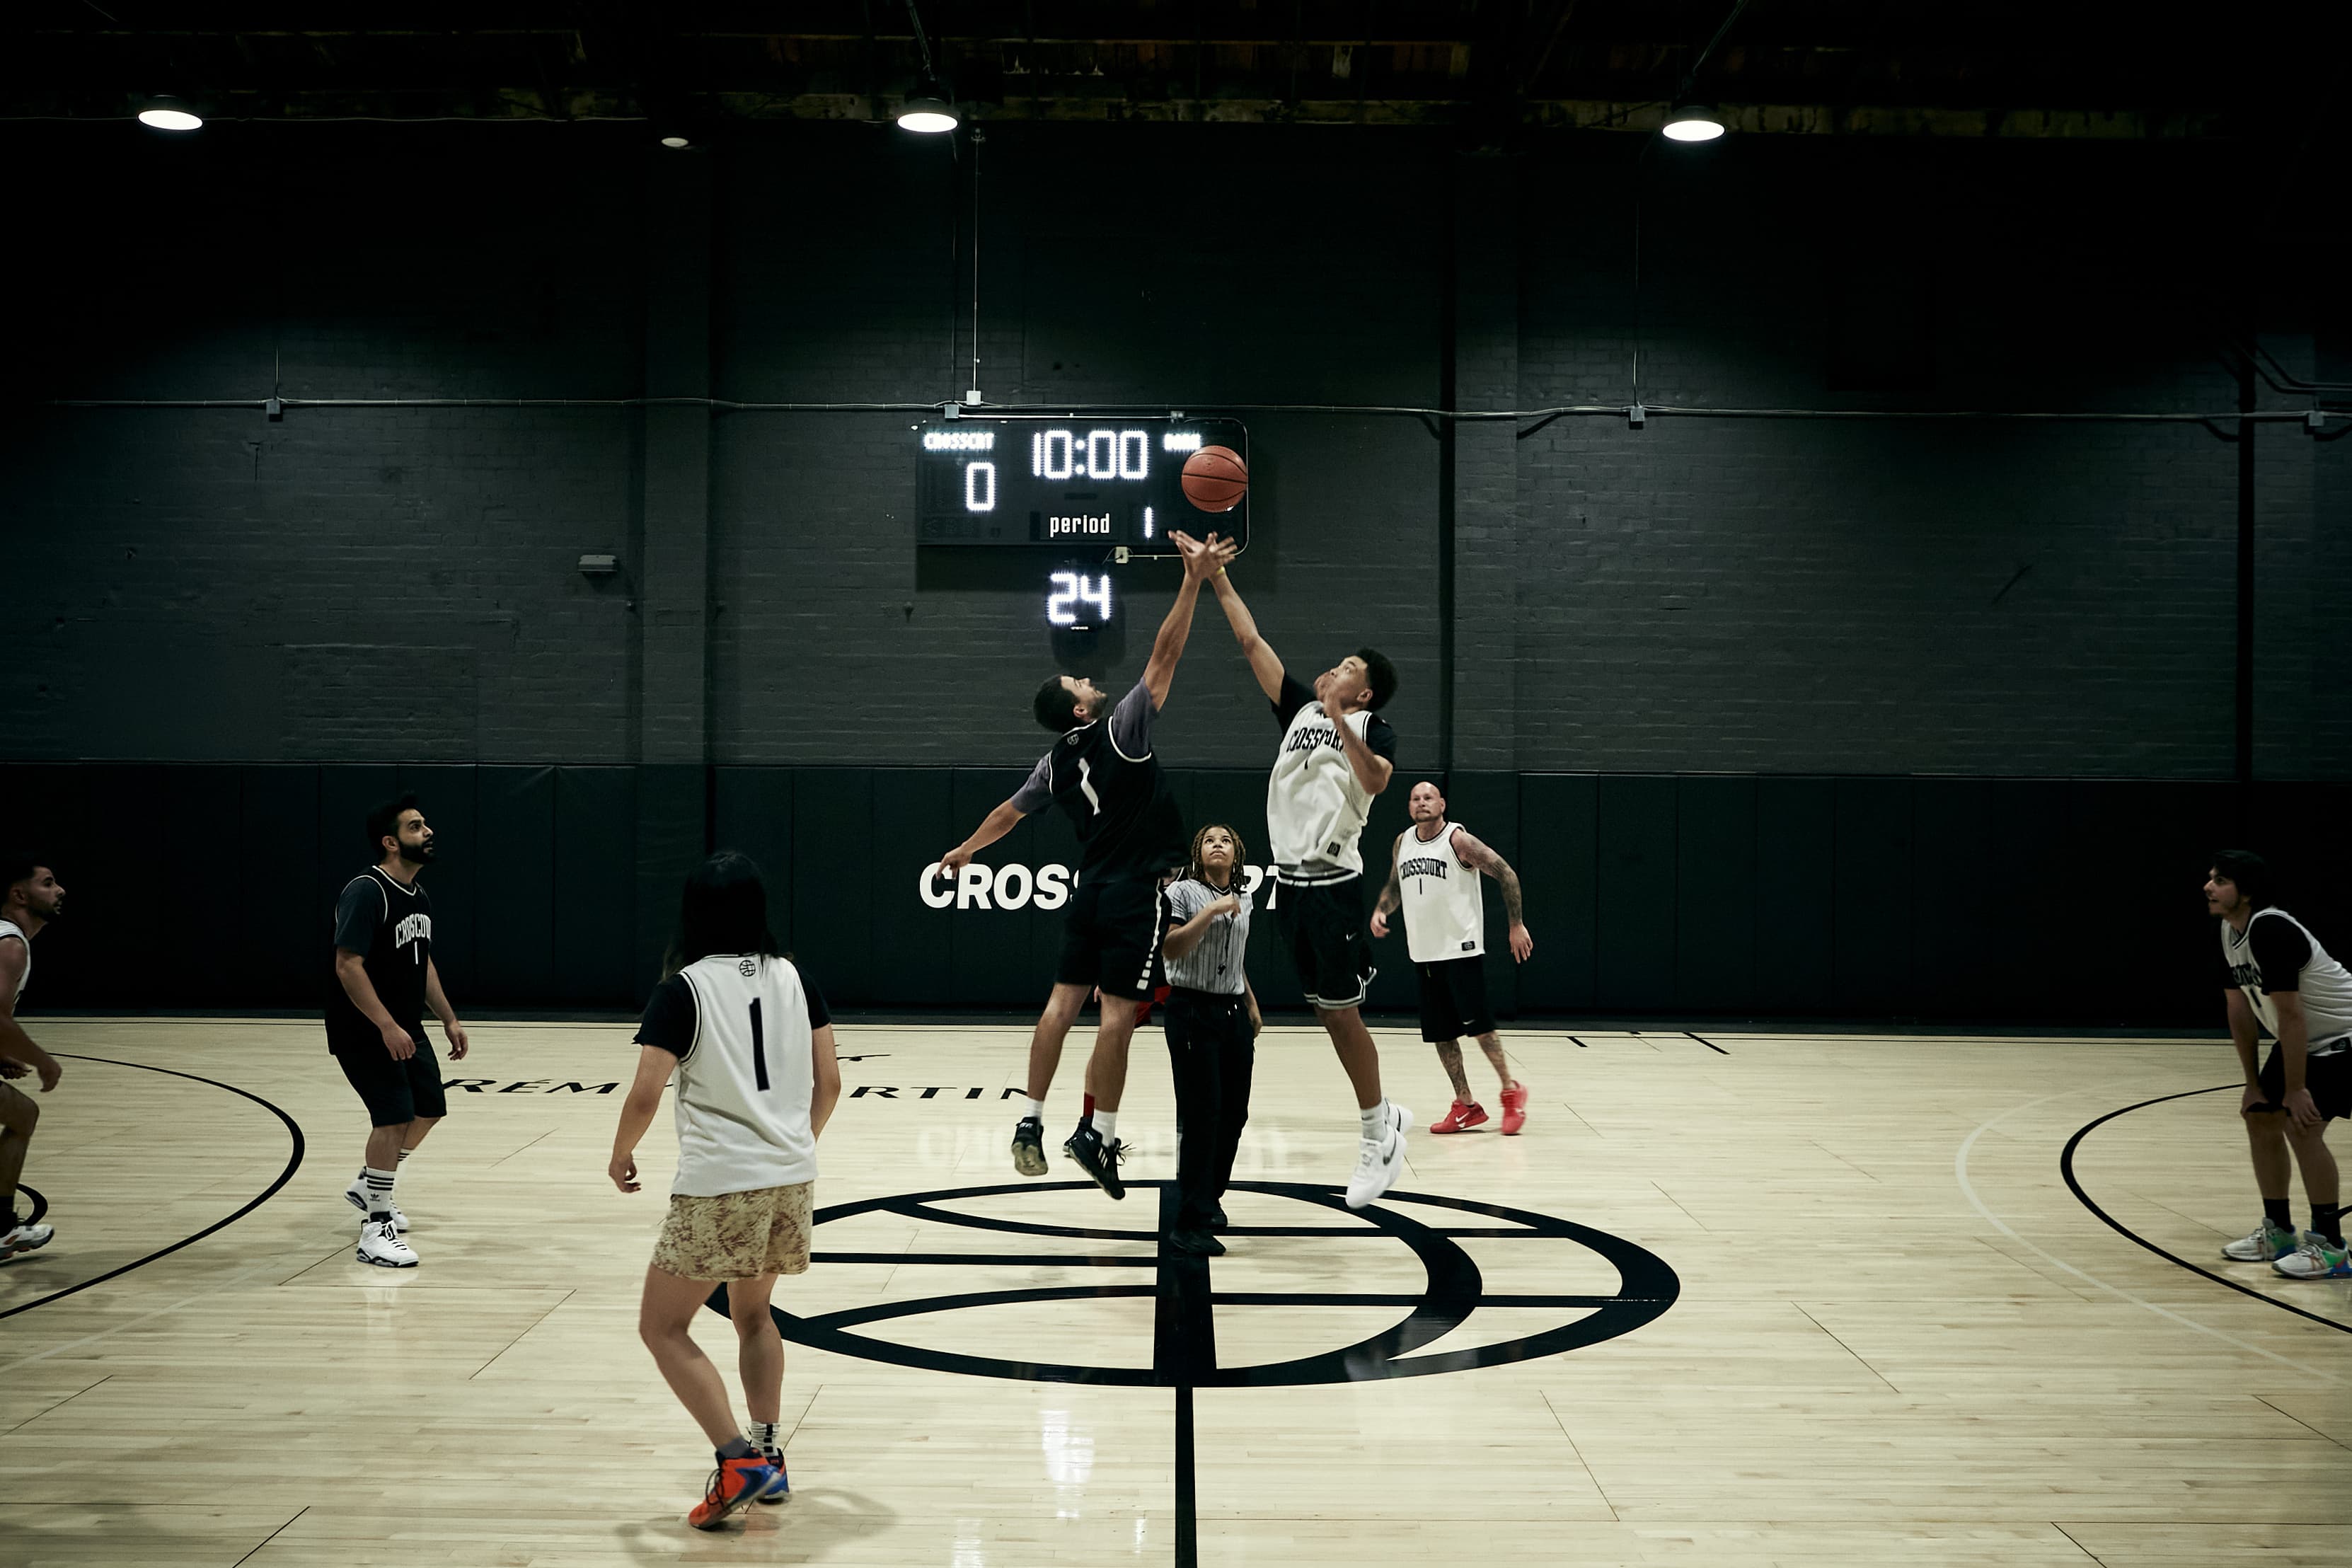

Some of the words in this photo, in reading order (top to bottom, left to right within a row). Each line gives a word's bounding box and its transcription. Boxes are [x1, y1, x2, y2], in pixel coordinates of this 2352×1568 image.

[1033, 430, 1148, 479] 10:00
[966, 461, 995, 511] 0
[1049, 513, 1110, 538] period
[1144, 506, 1153, 538] 1
[1048, 573, 1112, 623] 24
[414, 940, 419, 965] 1
[749, 996, 771, 1092] 1
[442, 1079, 674, 1095] RÉM
[849, 1086, 1028, 1100] RTIN
